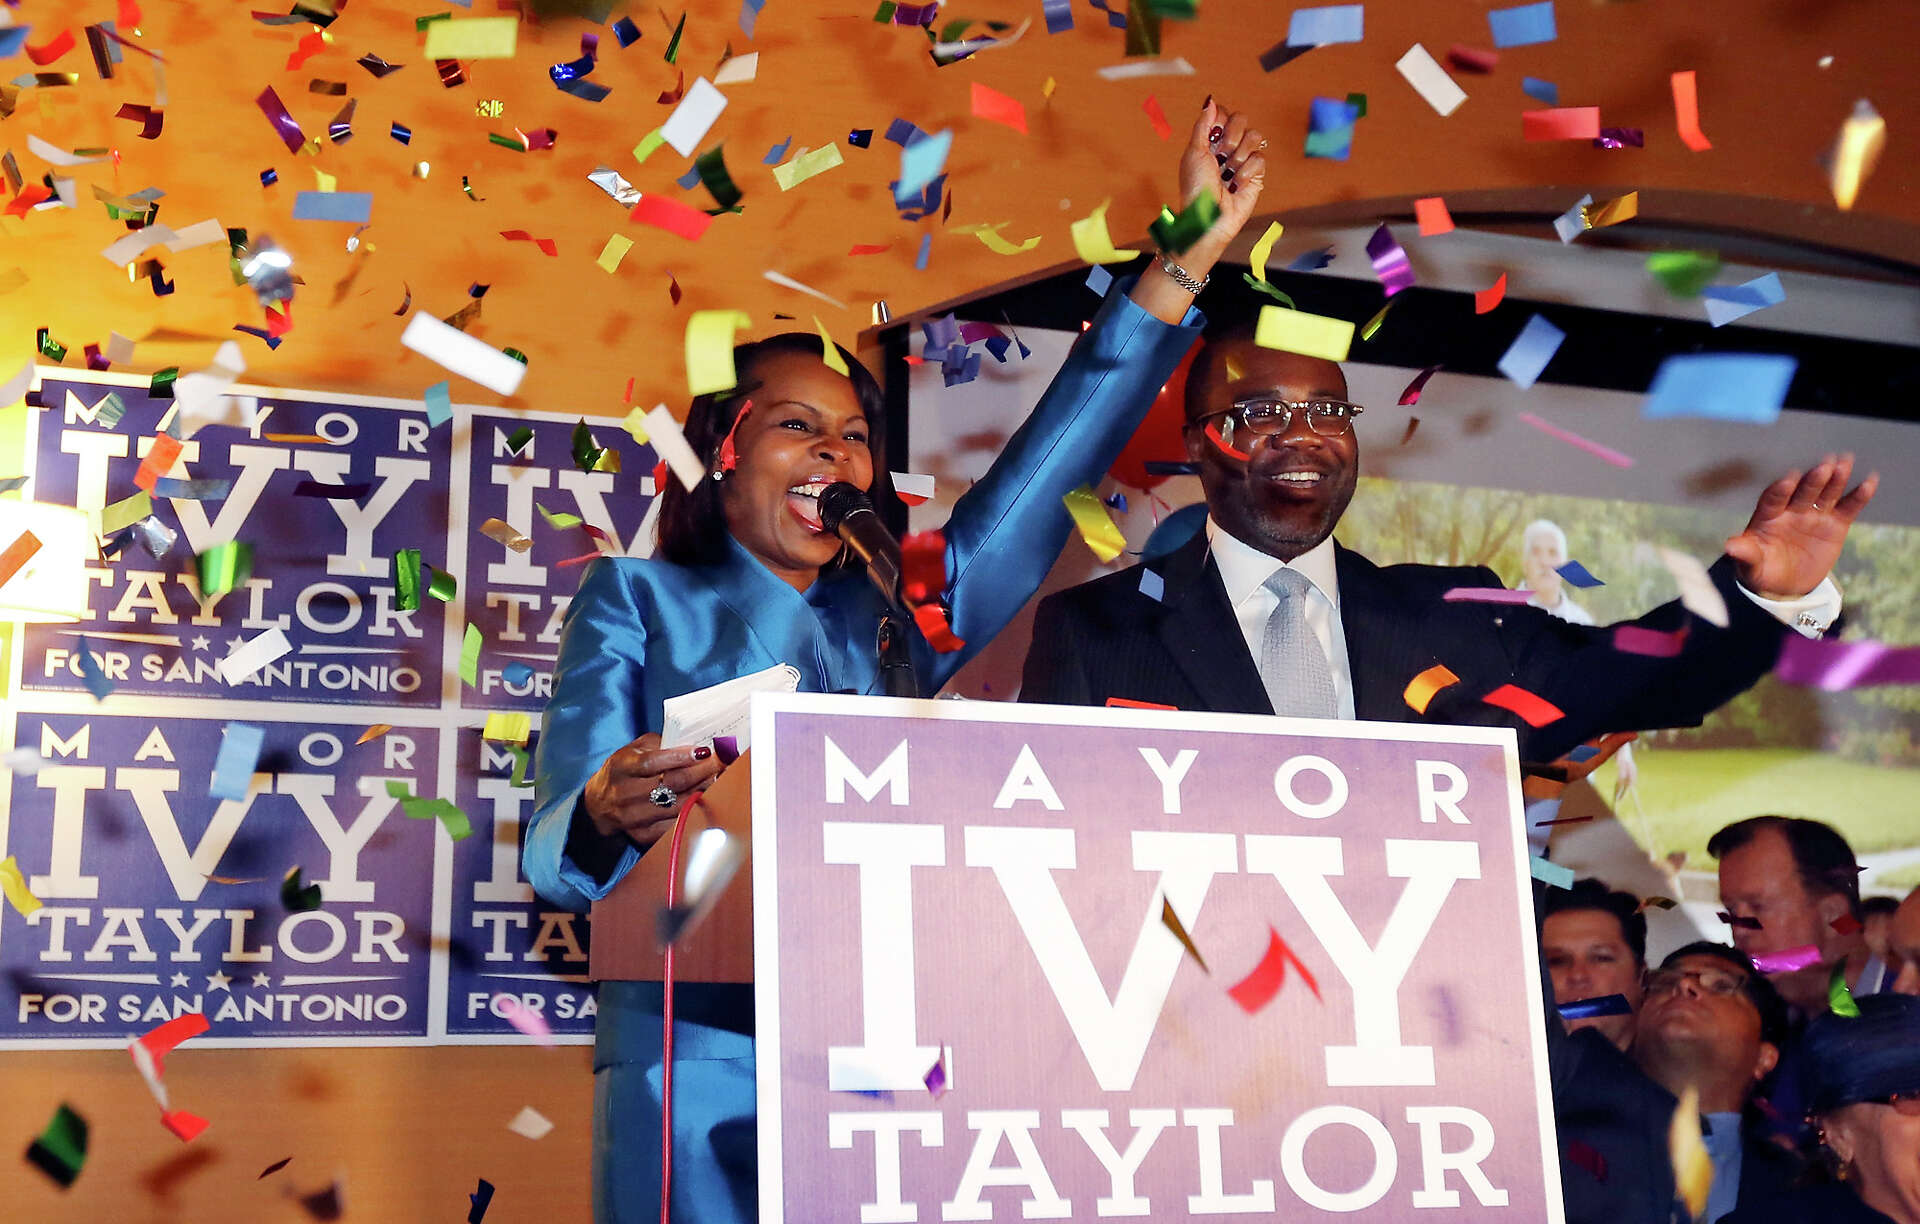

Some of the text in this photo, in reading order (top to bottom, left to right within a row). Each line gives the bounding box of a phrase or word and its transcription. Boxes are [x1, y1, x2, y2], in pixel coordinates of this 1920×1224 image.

[64, 388, 429, 454] MYOR
[60, 429, 431, 579] IVY
[488, 464, 664, 587] IV
[142, 652, 223, 685] SAN
[41, 721, 417, 770] MAOR
[824, 735, 1472, 825] MAYOR
[29, 765, 418, 903] IVY
[27, 907, 410, 964] TAYLOR
[824, 820, 1482, 1092] IVY
[18, 993, 408, 1024] FOR SAN ANTONIO
[467, 992, 598, 1019] FOR SA
[828, 1104, 1509, 1224] TAYLOR
